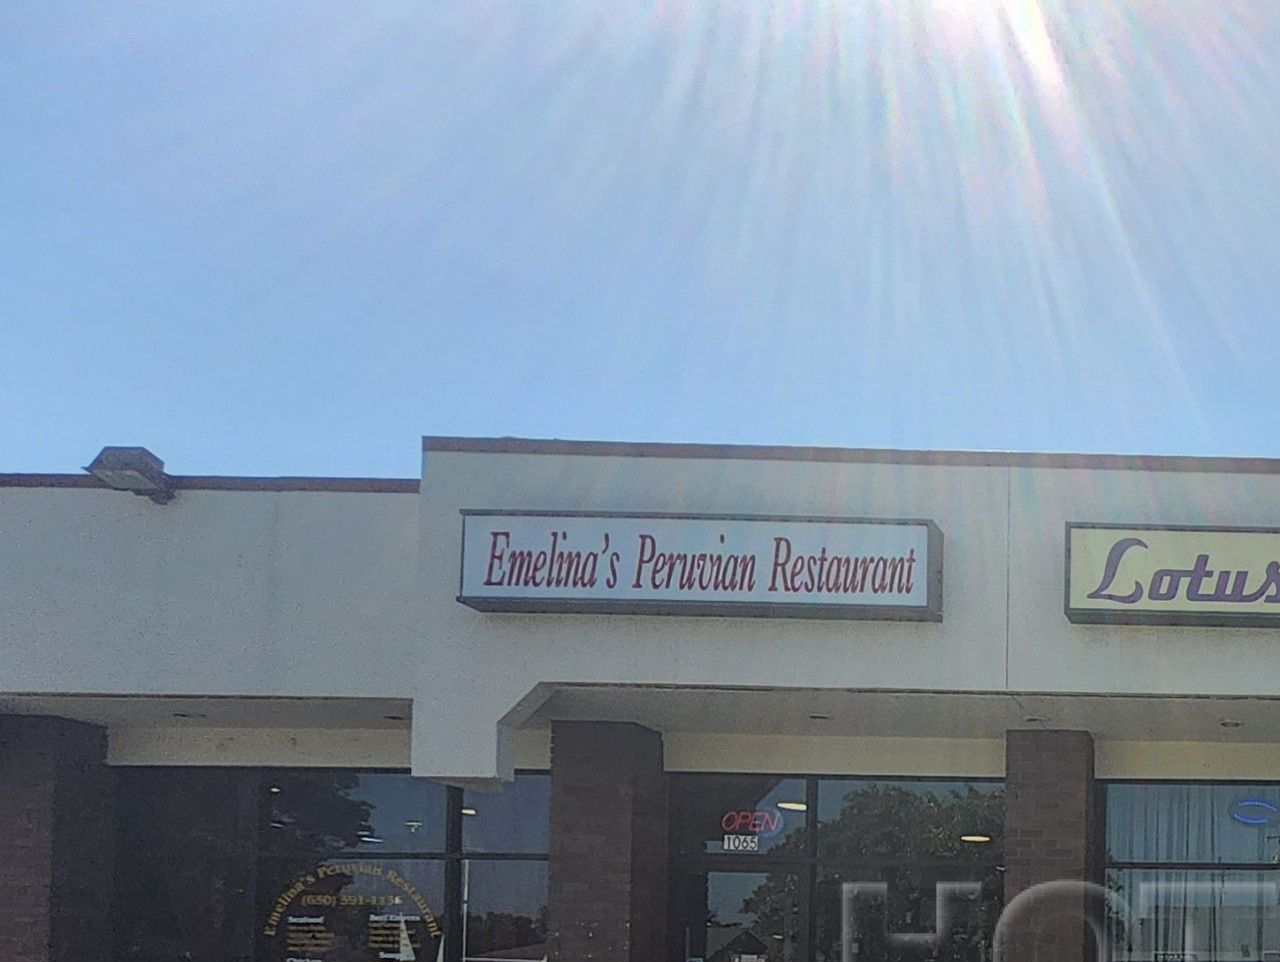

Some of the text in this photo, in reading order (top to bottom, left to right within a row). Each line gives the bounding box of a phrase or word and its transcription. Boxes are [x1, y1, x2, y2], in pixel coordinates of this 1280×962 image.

[483, 531, 917, 595] Emelina's Peruvian Restaurant
[721, 811, 780, 832] OPEN
[726, 836, 757, 850] 1065
[386, 869, 443, 937] Restaurant
